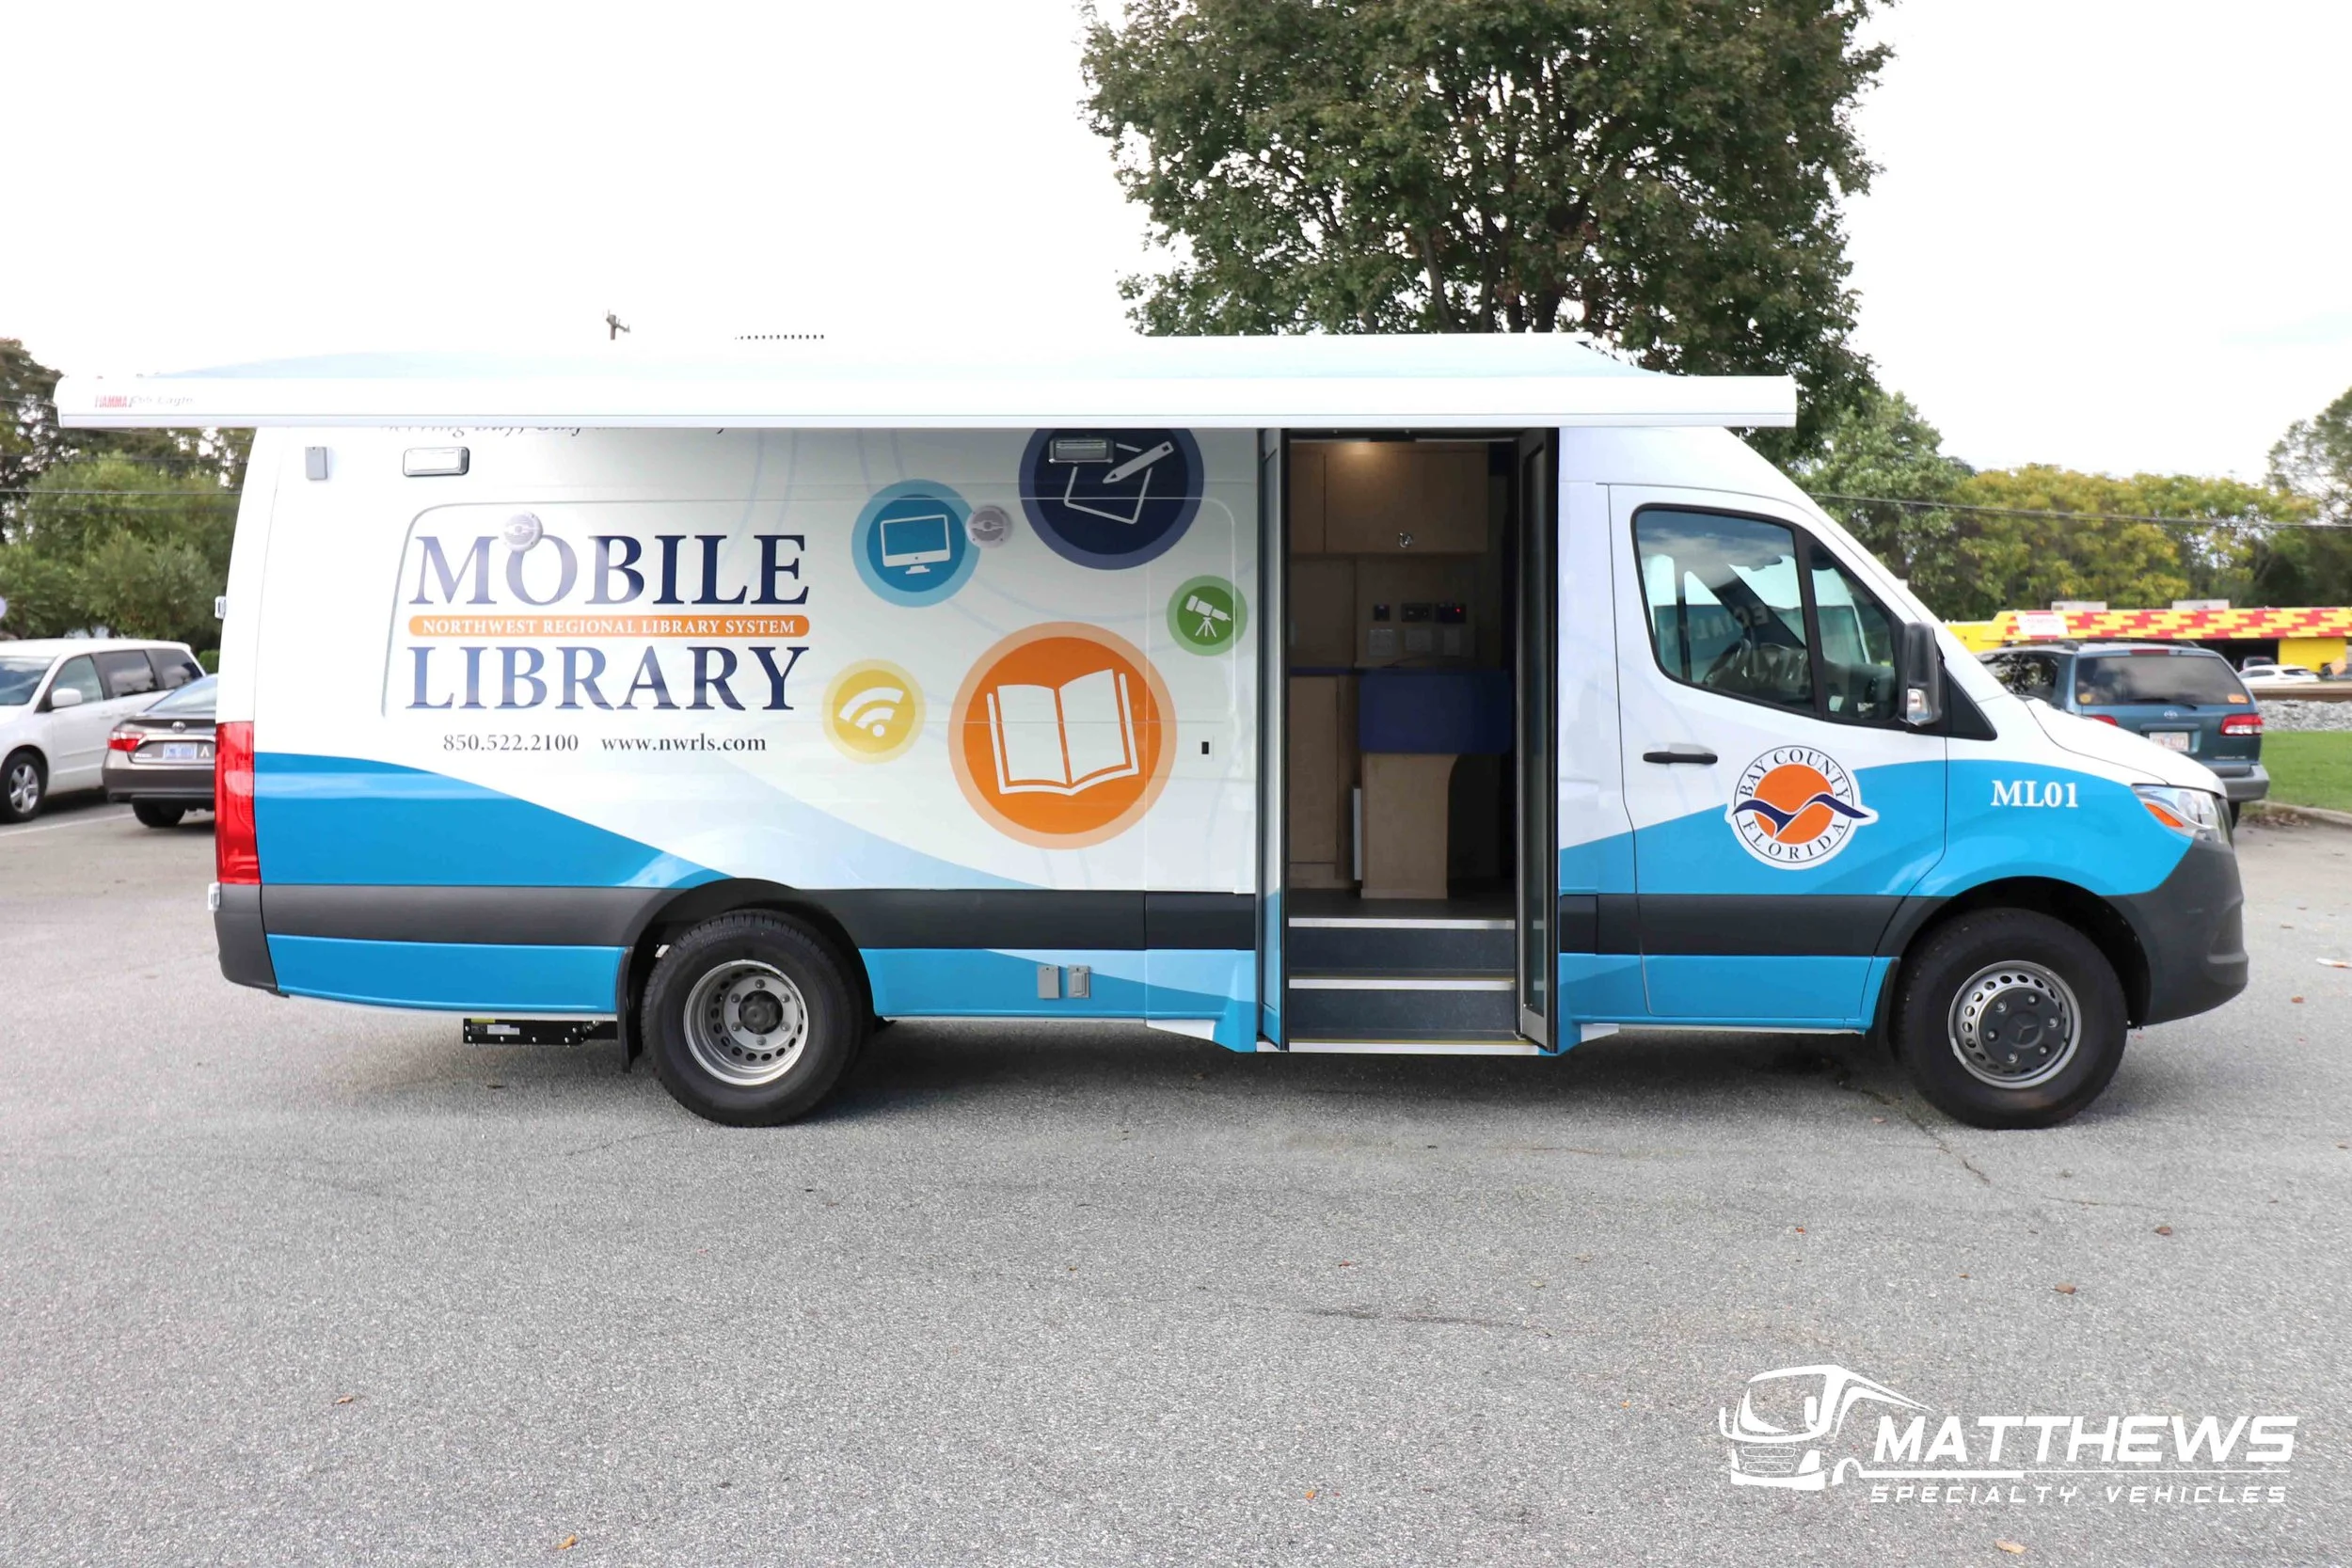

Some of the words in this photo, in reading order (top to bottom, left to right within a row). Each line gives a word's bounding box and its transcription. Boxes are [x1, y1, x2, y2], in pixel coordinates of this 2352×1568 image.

[408, 534, 810, 607] MOBILE
[421, 619, 538, 635] NORTHWEST
[543, 619, 639, 634] REGIONAL
[642, 619, 720, 634] LIBRARY
[725, 619, 795, 634] SYSTEM
[405, 645, 810, 712] LIBRARY
[442, 734, 580, 752] 850.522.2100
[600, 732, 767, 752] www.nwrls.com
[1739, 759, 1769, 798] BAY
[1772, 748, 1851, 800] COUNTY
[1990, 779, 2079, 808] ML01
[1741, 819, 1846, 860] FLORIDA
